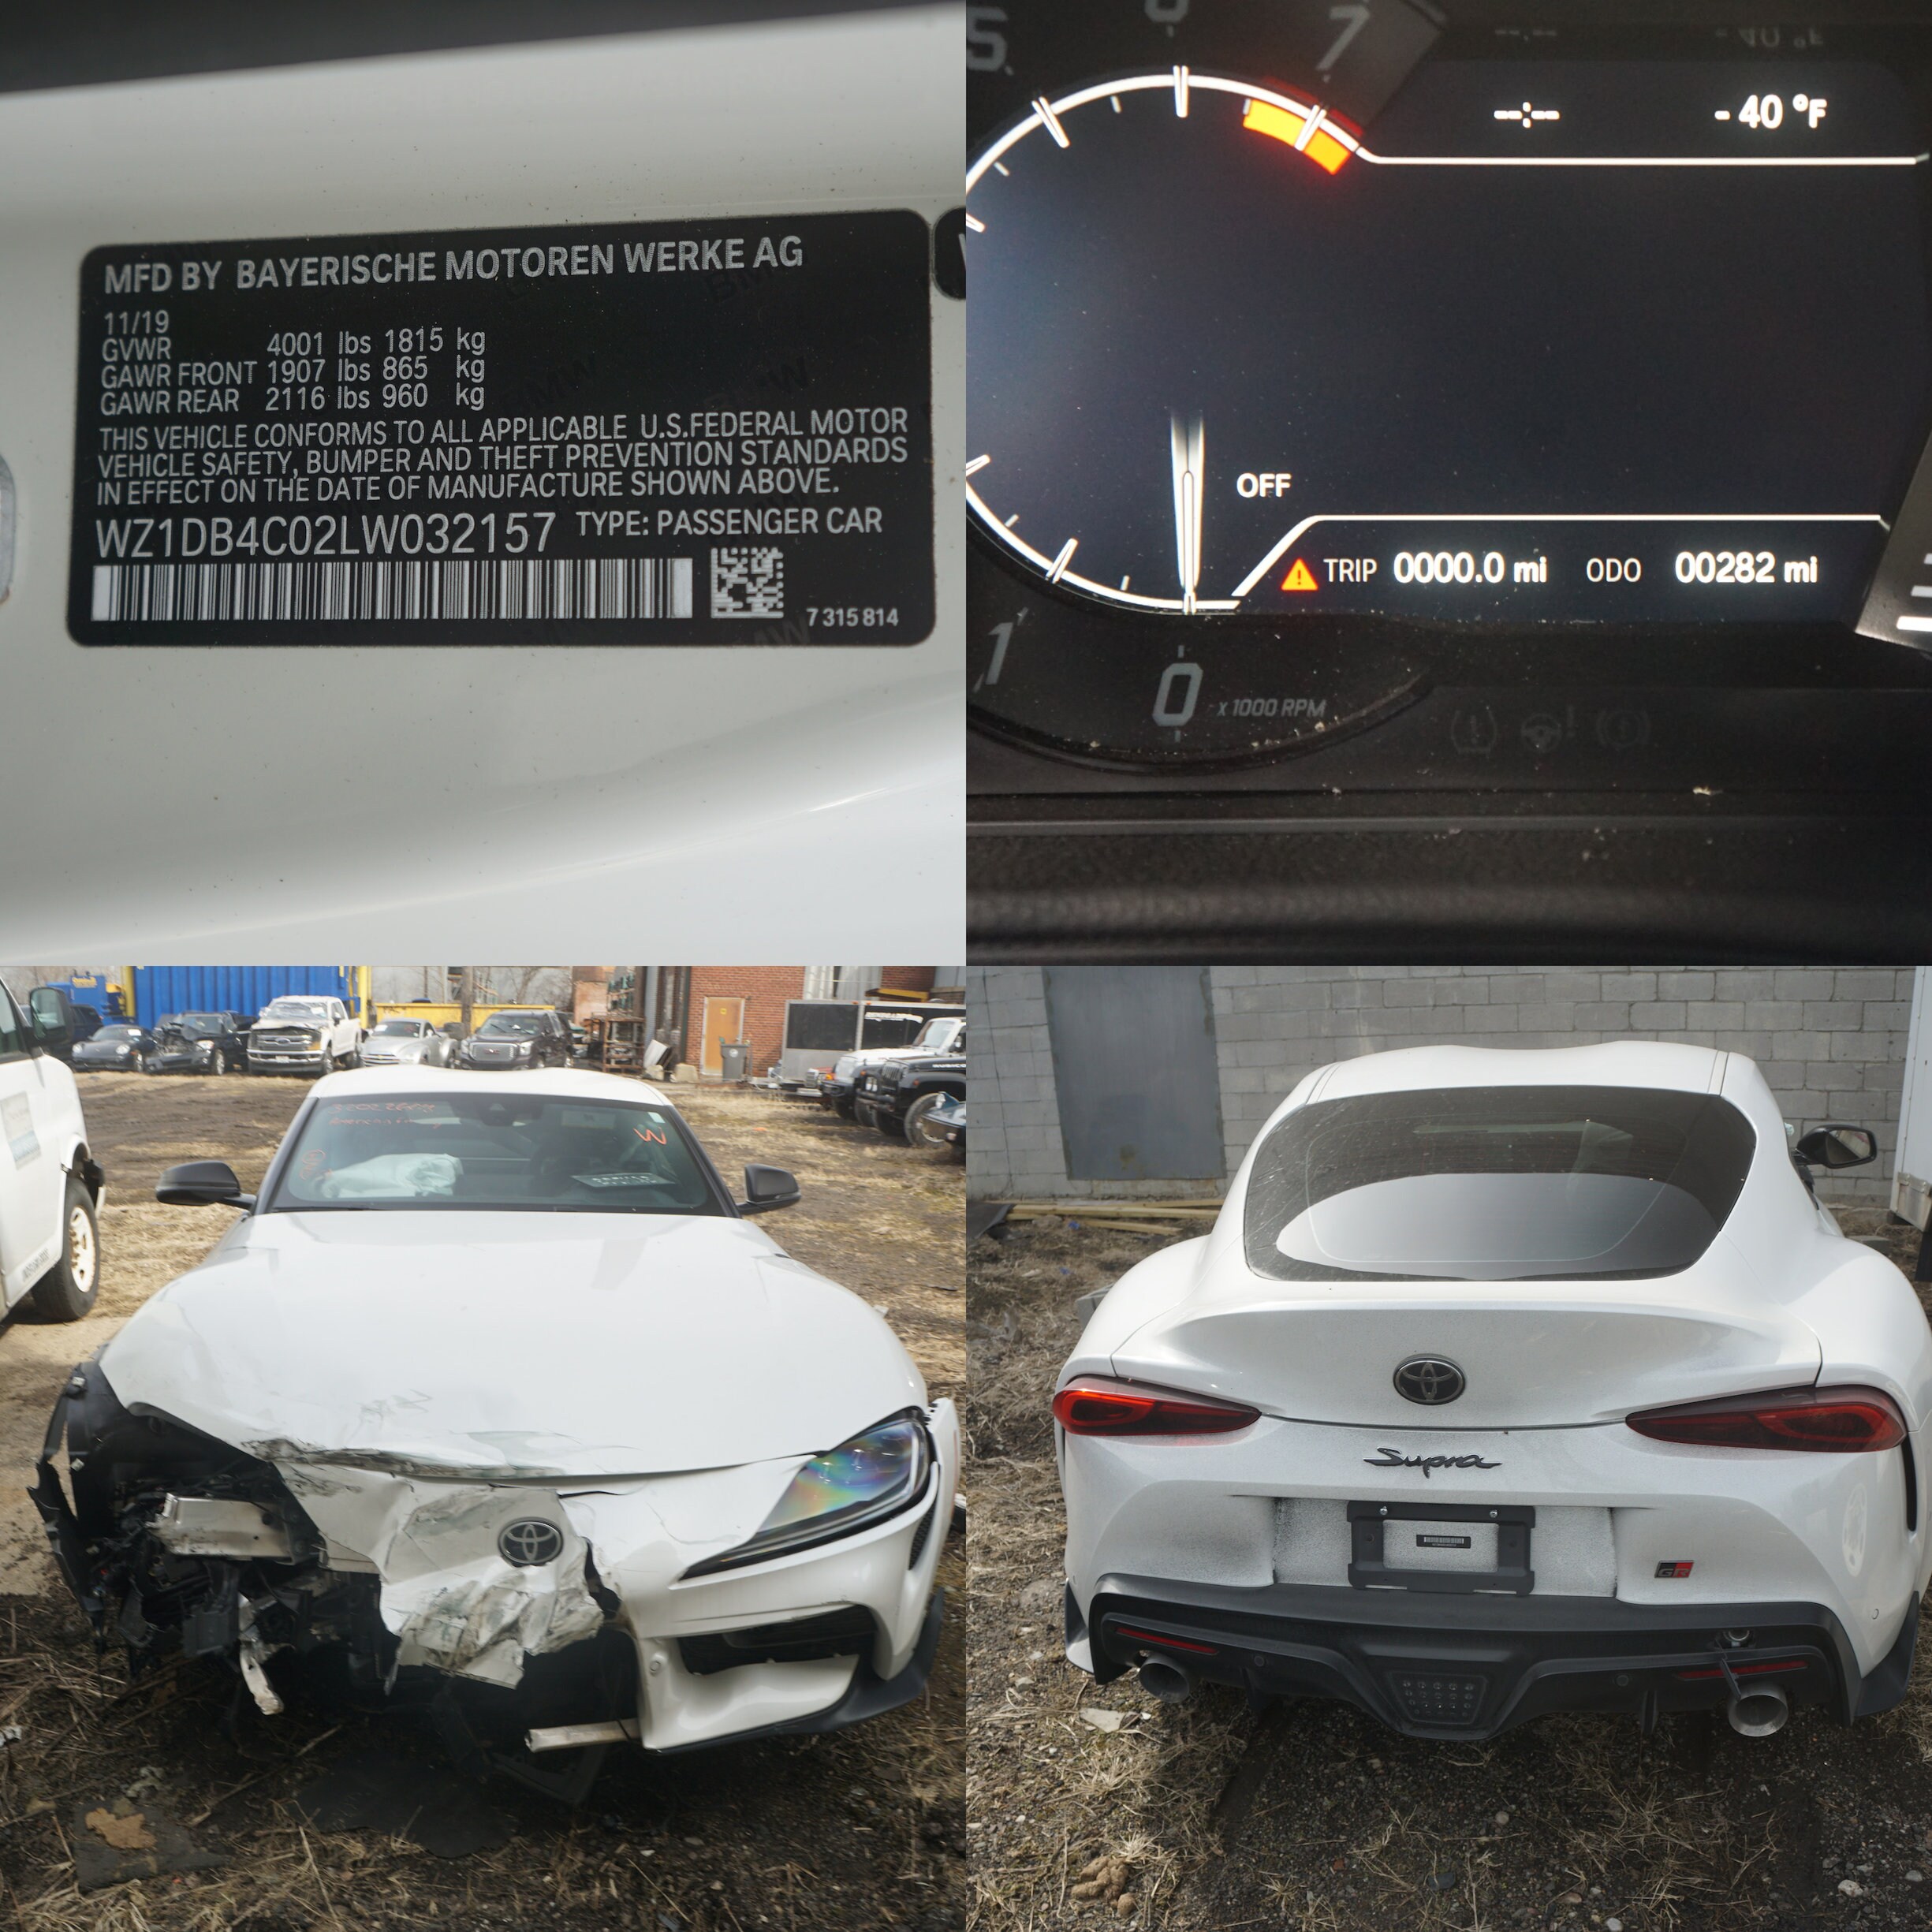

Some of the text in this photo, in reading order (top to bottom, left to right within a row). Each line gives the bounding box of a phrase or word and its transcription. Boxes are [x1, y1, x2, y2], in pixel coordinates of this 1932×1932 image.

[1316, 5, 1370, 72] 7
[106, 236, 802, 293] MFD BY BAYERISCHE MOTOREN WERKE AG
[106, 311, 168, 334] 11/19
[103, 327, 485, 361] GVWR 4001 lbs 1815 kg
[102, 355, 484, 388] GAWR FRONT 1907 lbs 865 kg
[102, 382, 484, 415] GAWR REAR 2116 lbs 960 kg
[100, 427, 147, 450] THIS
[155, 424, 247, 449] VEHICLE
[255, 421, 386, 447] CONFORMS
[393, 420, 424, 444] TO
[431, 420, 473, 443] ALL
[479, 415, 627, 442] APPLICABLE
[811, 408, 907, 435] MOTOR
[99, 437, 907, 479] VEHICLE SAFETY, BUMPER AND THEFT PREVENTION STANDARDS
[98, 468, 839, 505] IN EFFECT ON THE DATE OF MANUFACTURE SHOWN ABOVE.
[1236, 473, 1292, 498] OFF
[96, 507, 882, 558] WZ1DB4C02LW032157 TYPE: PASSENGER CAR
[1323, 551, 1547, 584] TRIP 0000.0 mi
[1586, 551, 1818, 584] ODO 00282 mi
[1152, 662, 1203, 726] 0
[1281, 699, 1326, 717] RPM
[1363, 1447, 1502, 1479] Supra
